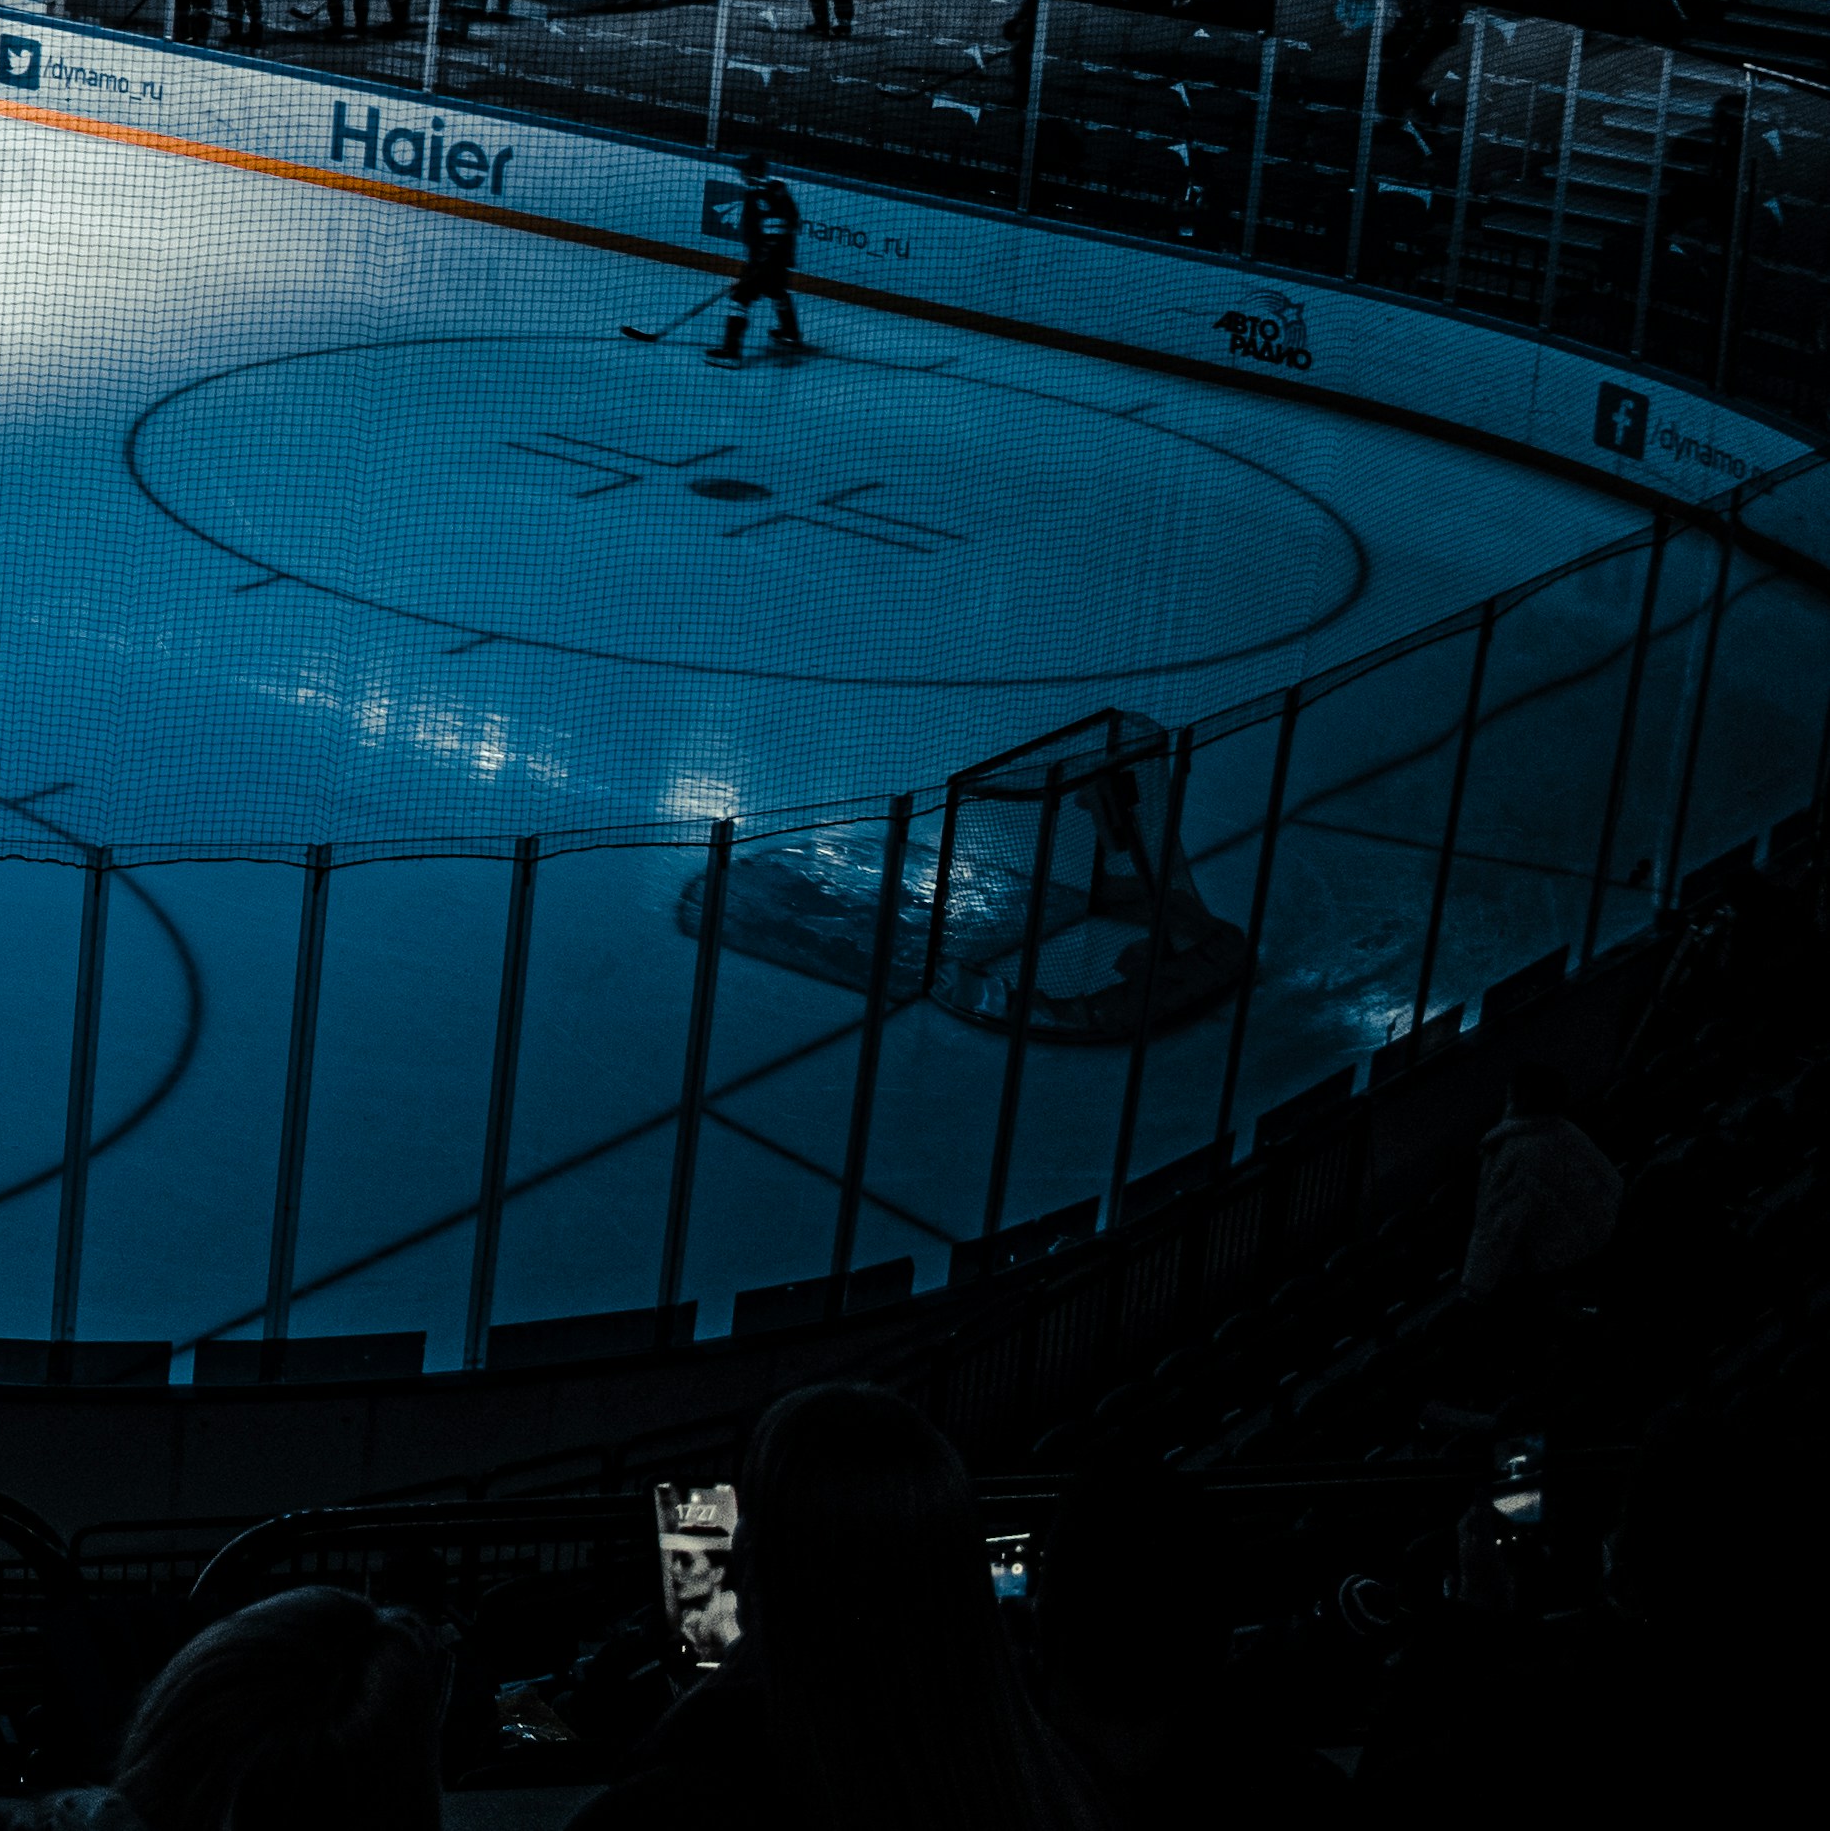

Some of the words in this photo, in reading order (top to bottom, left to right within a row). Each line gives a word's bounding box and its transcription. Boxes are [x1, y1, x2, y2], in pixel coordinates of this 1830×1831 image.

[41, 54, 165, 103] /dynamo_ru
[330, 99, 514, 196] Haier
[1212, 308, 1281, 343] АВТО
[1229, 334, 1314, 372] РАДИО
